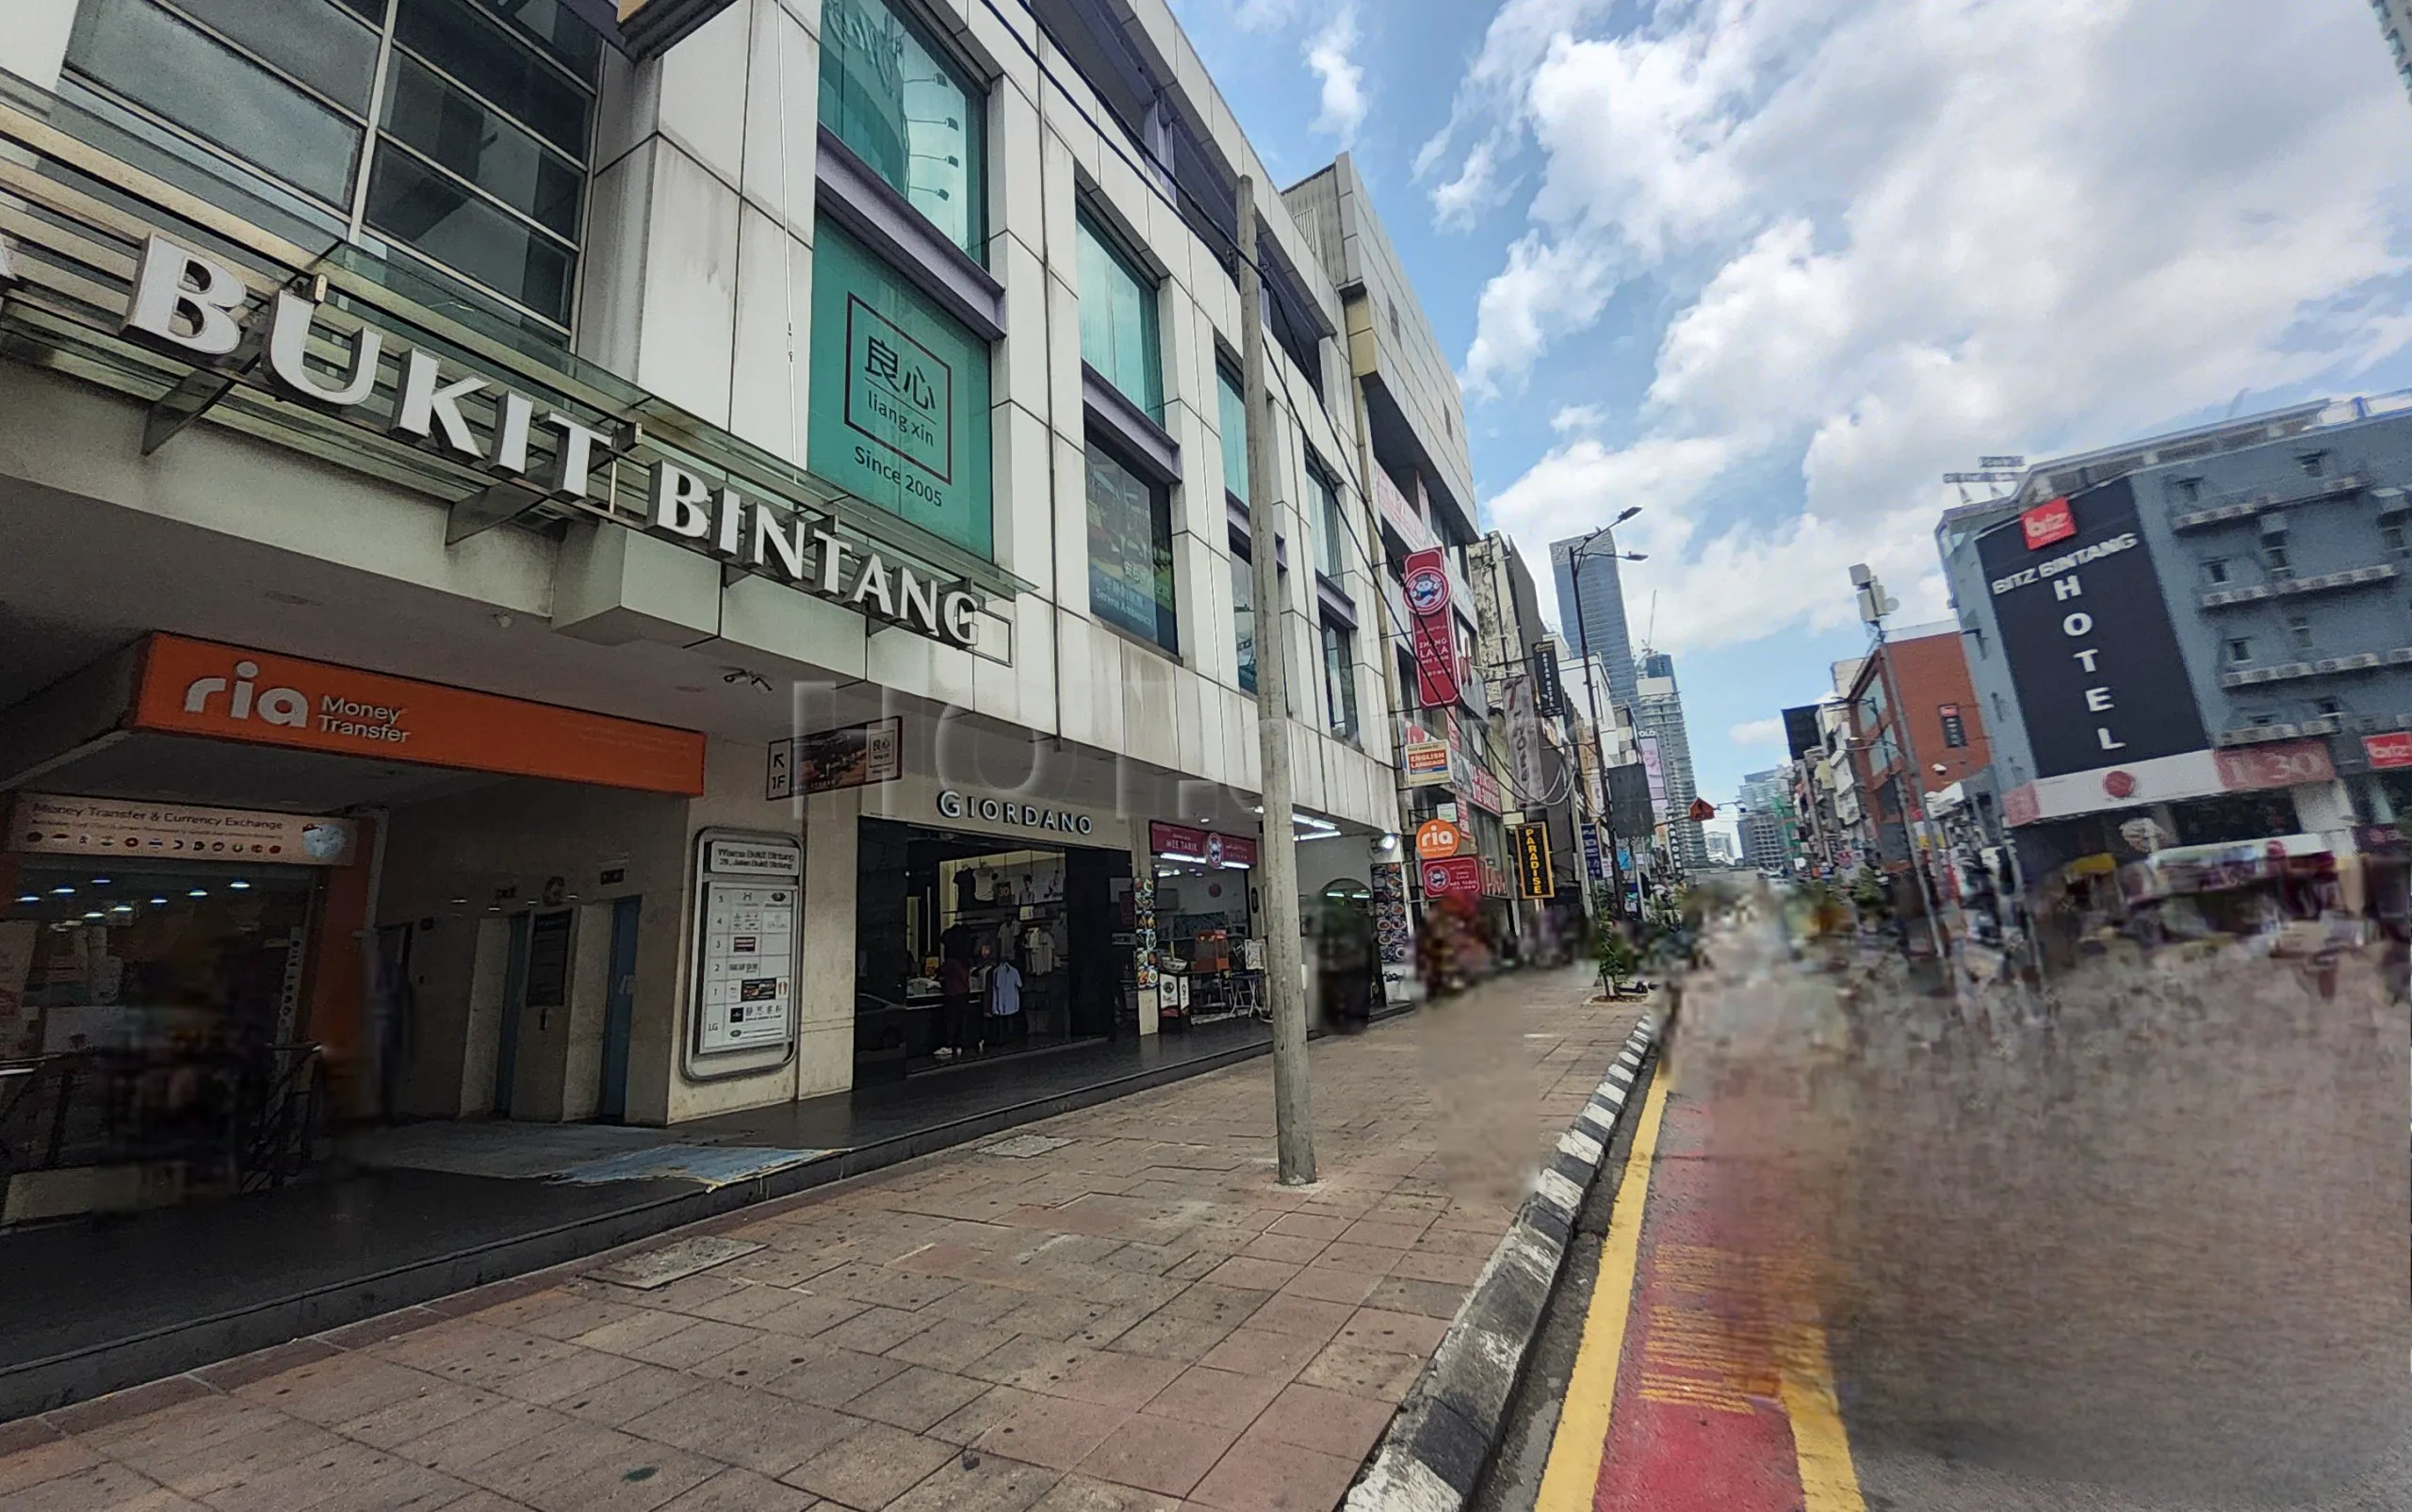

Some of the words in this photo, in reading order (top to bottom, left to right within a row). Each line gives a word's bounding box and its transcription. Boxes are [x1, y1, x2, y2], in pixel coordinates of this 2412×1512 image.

[863, 335, 937, 411] 良心
[122, 232, 613, 500] BUKIT
[648, 459, 980, 647] BINTANG
[867, 391, 908, 434] liang
[910, 418, 935, 447] xin
[854, 445, 902, 484] Since
[904, 472, 943, 508] 2005
[2038, 531, 2139, 578] BINTANG
[1420, 645, 1449, 658] LAA
[2052, 574, 2127, 751] HOTEL
[185, 660, 310, 729] ria
[320, 694, 402, 723] Money
[317, 713, 412, 745] Transfer
[1410, 753, 1445, 762] ENGLISH
[771, 774, 787, 790] 1F
[32, 802, 85, 819] Money
[89, 805, 148, 822] Transfer
[150, 811, 160, 822] &
[163, 811, 222, 828] Currency
[224, 816, 285, 832] Exchange
[937, 790, 1094, 835] GIORDANO
[1421, 824, 1454, 847] ria
[1524, 828, 1542, 894] PARADISE
[708, 1022, 719, 1032] LG
